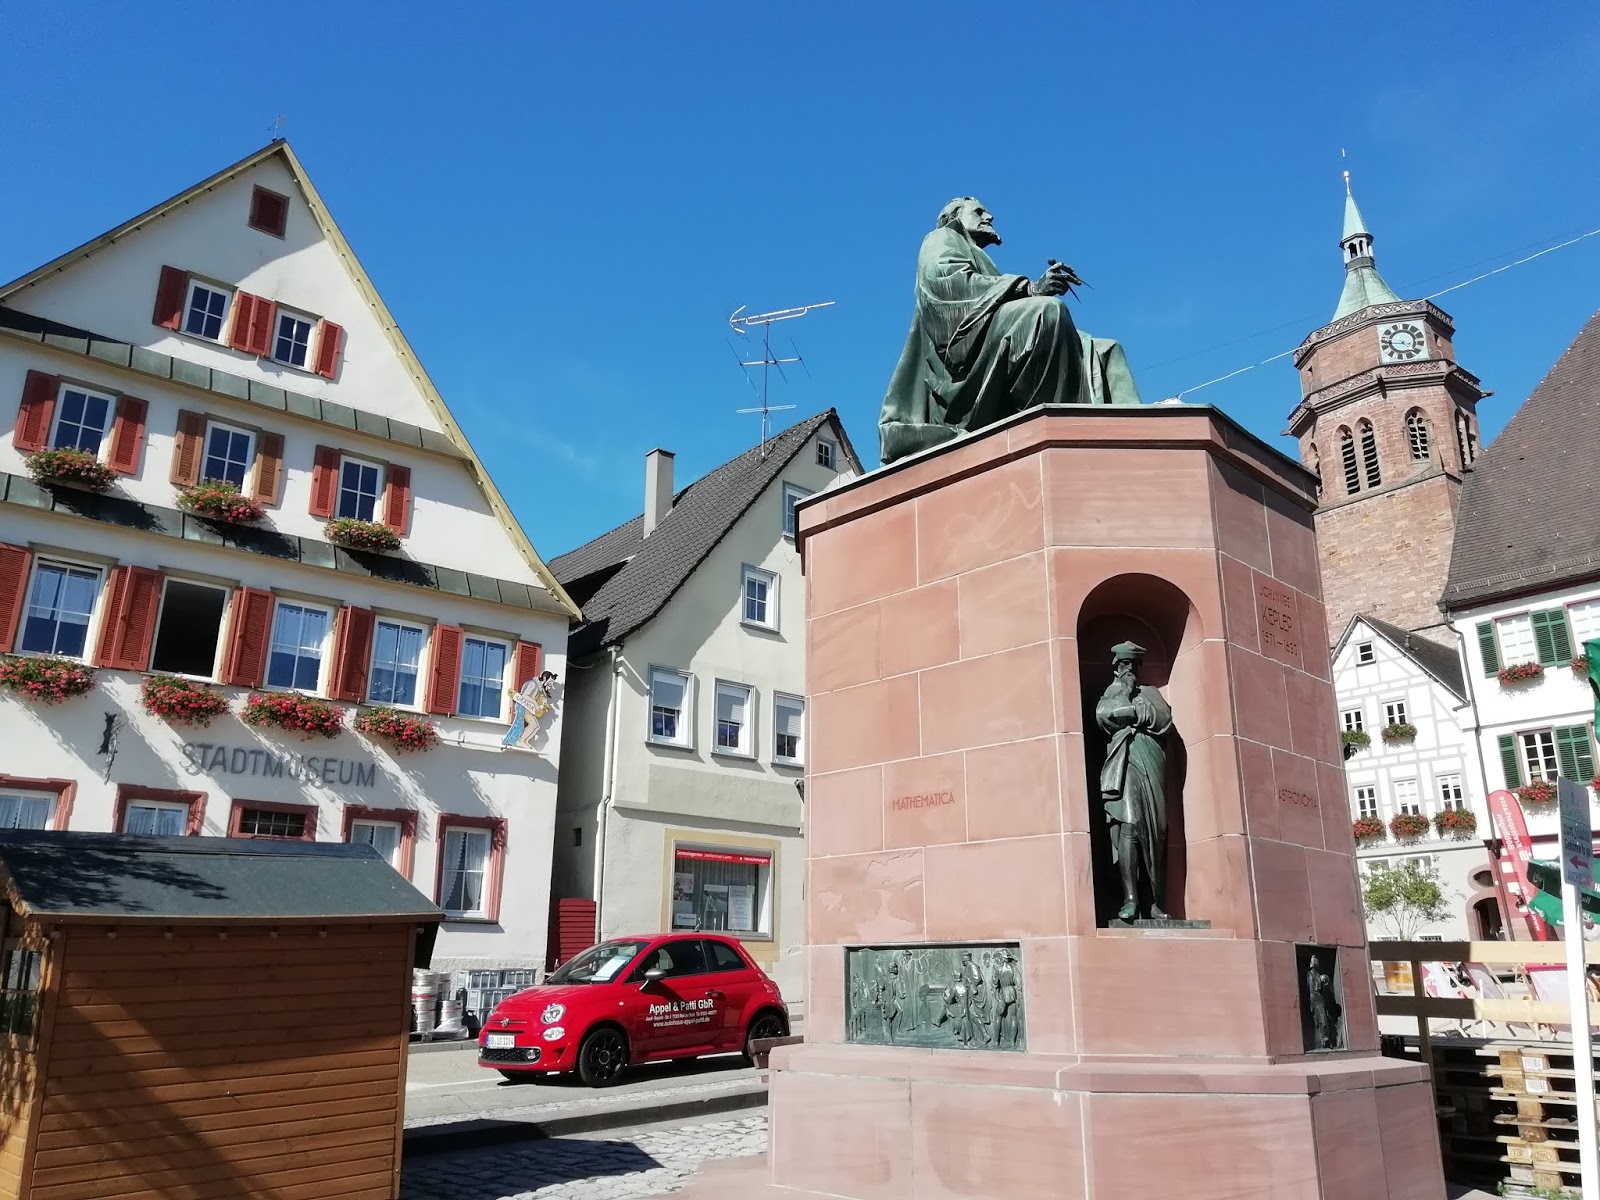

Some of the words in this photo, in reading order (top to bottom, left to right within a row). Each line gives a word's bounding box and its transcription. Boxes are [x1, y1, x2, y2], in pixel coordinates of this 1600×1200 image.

[1261, 604, 1293, 632] KEPLER
[179, 742, 377, 788] STADTMUSEUM
[892, 792, 956, 812] MATHEMATICA
[649, 1002, 672, 1015] Appel
[673, 1001, 679, 1011] &
[680, 1000, 697, 1011] Patti
[698, 999, 714, 1009] GbR
